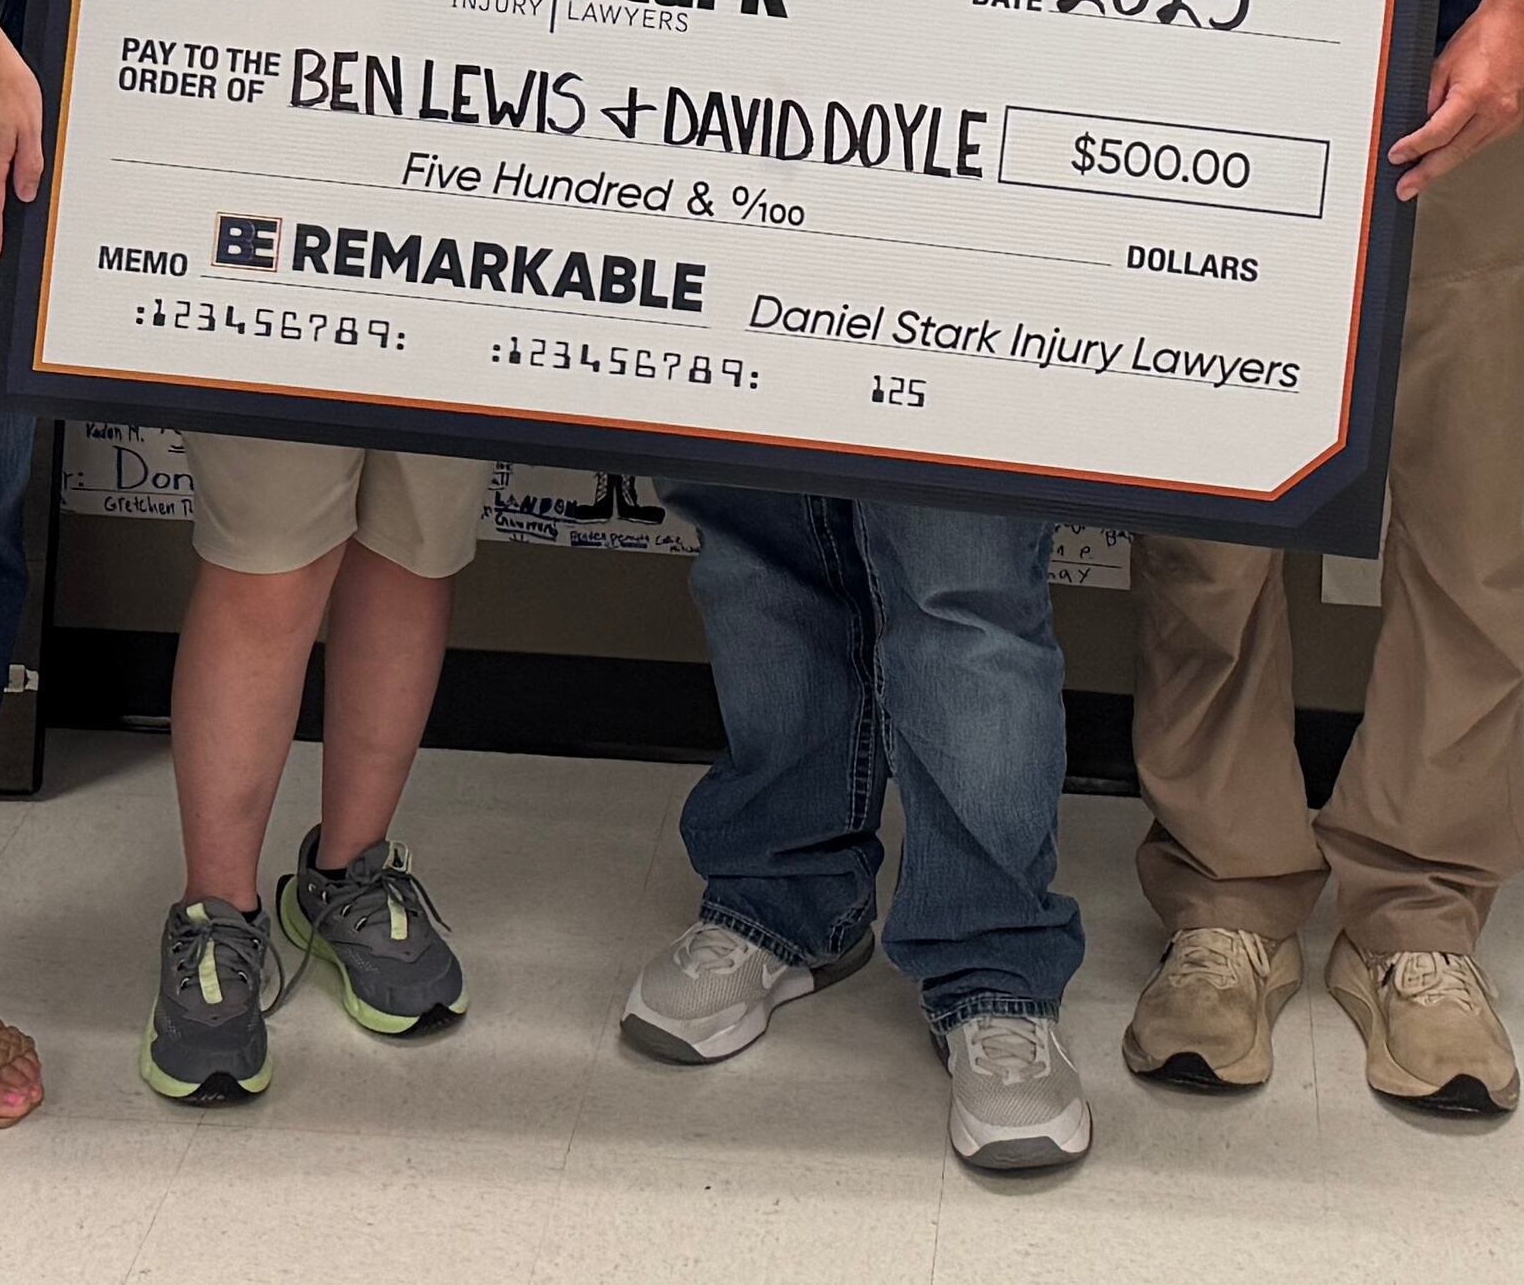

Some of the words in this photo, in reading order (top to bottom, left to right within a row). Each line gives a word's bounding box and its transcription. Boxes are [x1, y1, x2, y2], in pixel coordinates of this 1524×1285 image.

[567, 0, 690, 33] LAWYERS
[121, 37, 177, 65] PAY
[183, 43, 220, 70] TO
[226, 47, 281, 77] THE
[118, 65, 216, 98] ORDER
[227, 76, 266, 103] OF
[290, 47, 404, 116] BEN
[417, 57, 586, 135] LEWIS
[664, 86, 815, 162] DAVID
[824, 100, 988, 179] DOYLE
[400, 151, 483, 193] Five
[492, 159, 674, 216] Hundred
[686, 179, 715, 219] &
[1070, 130, 1252, 190] $500.00
[97, 244, 189, 277] MEMO
[291, 221, 707, 314] REMARKABLE
[1126, 244, 1260, 284] DOLLARS
[749, 294, 885, 342] Daniel
[891, 311, 1000, 357] Stark
[1008, 321, 1124, 375] Injury
[1131, 336, 1301, 390] Lawyers
[871, 373, 927, 408] 125
[103, 494, 176, 516] Gretchen
